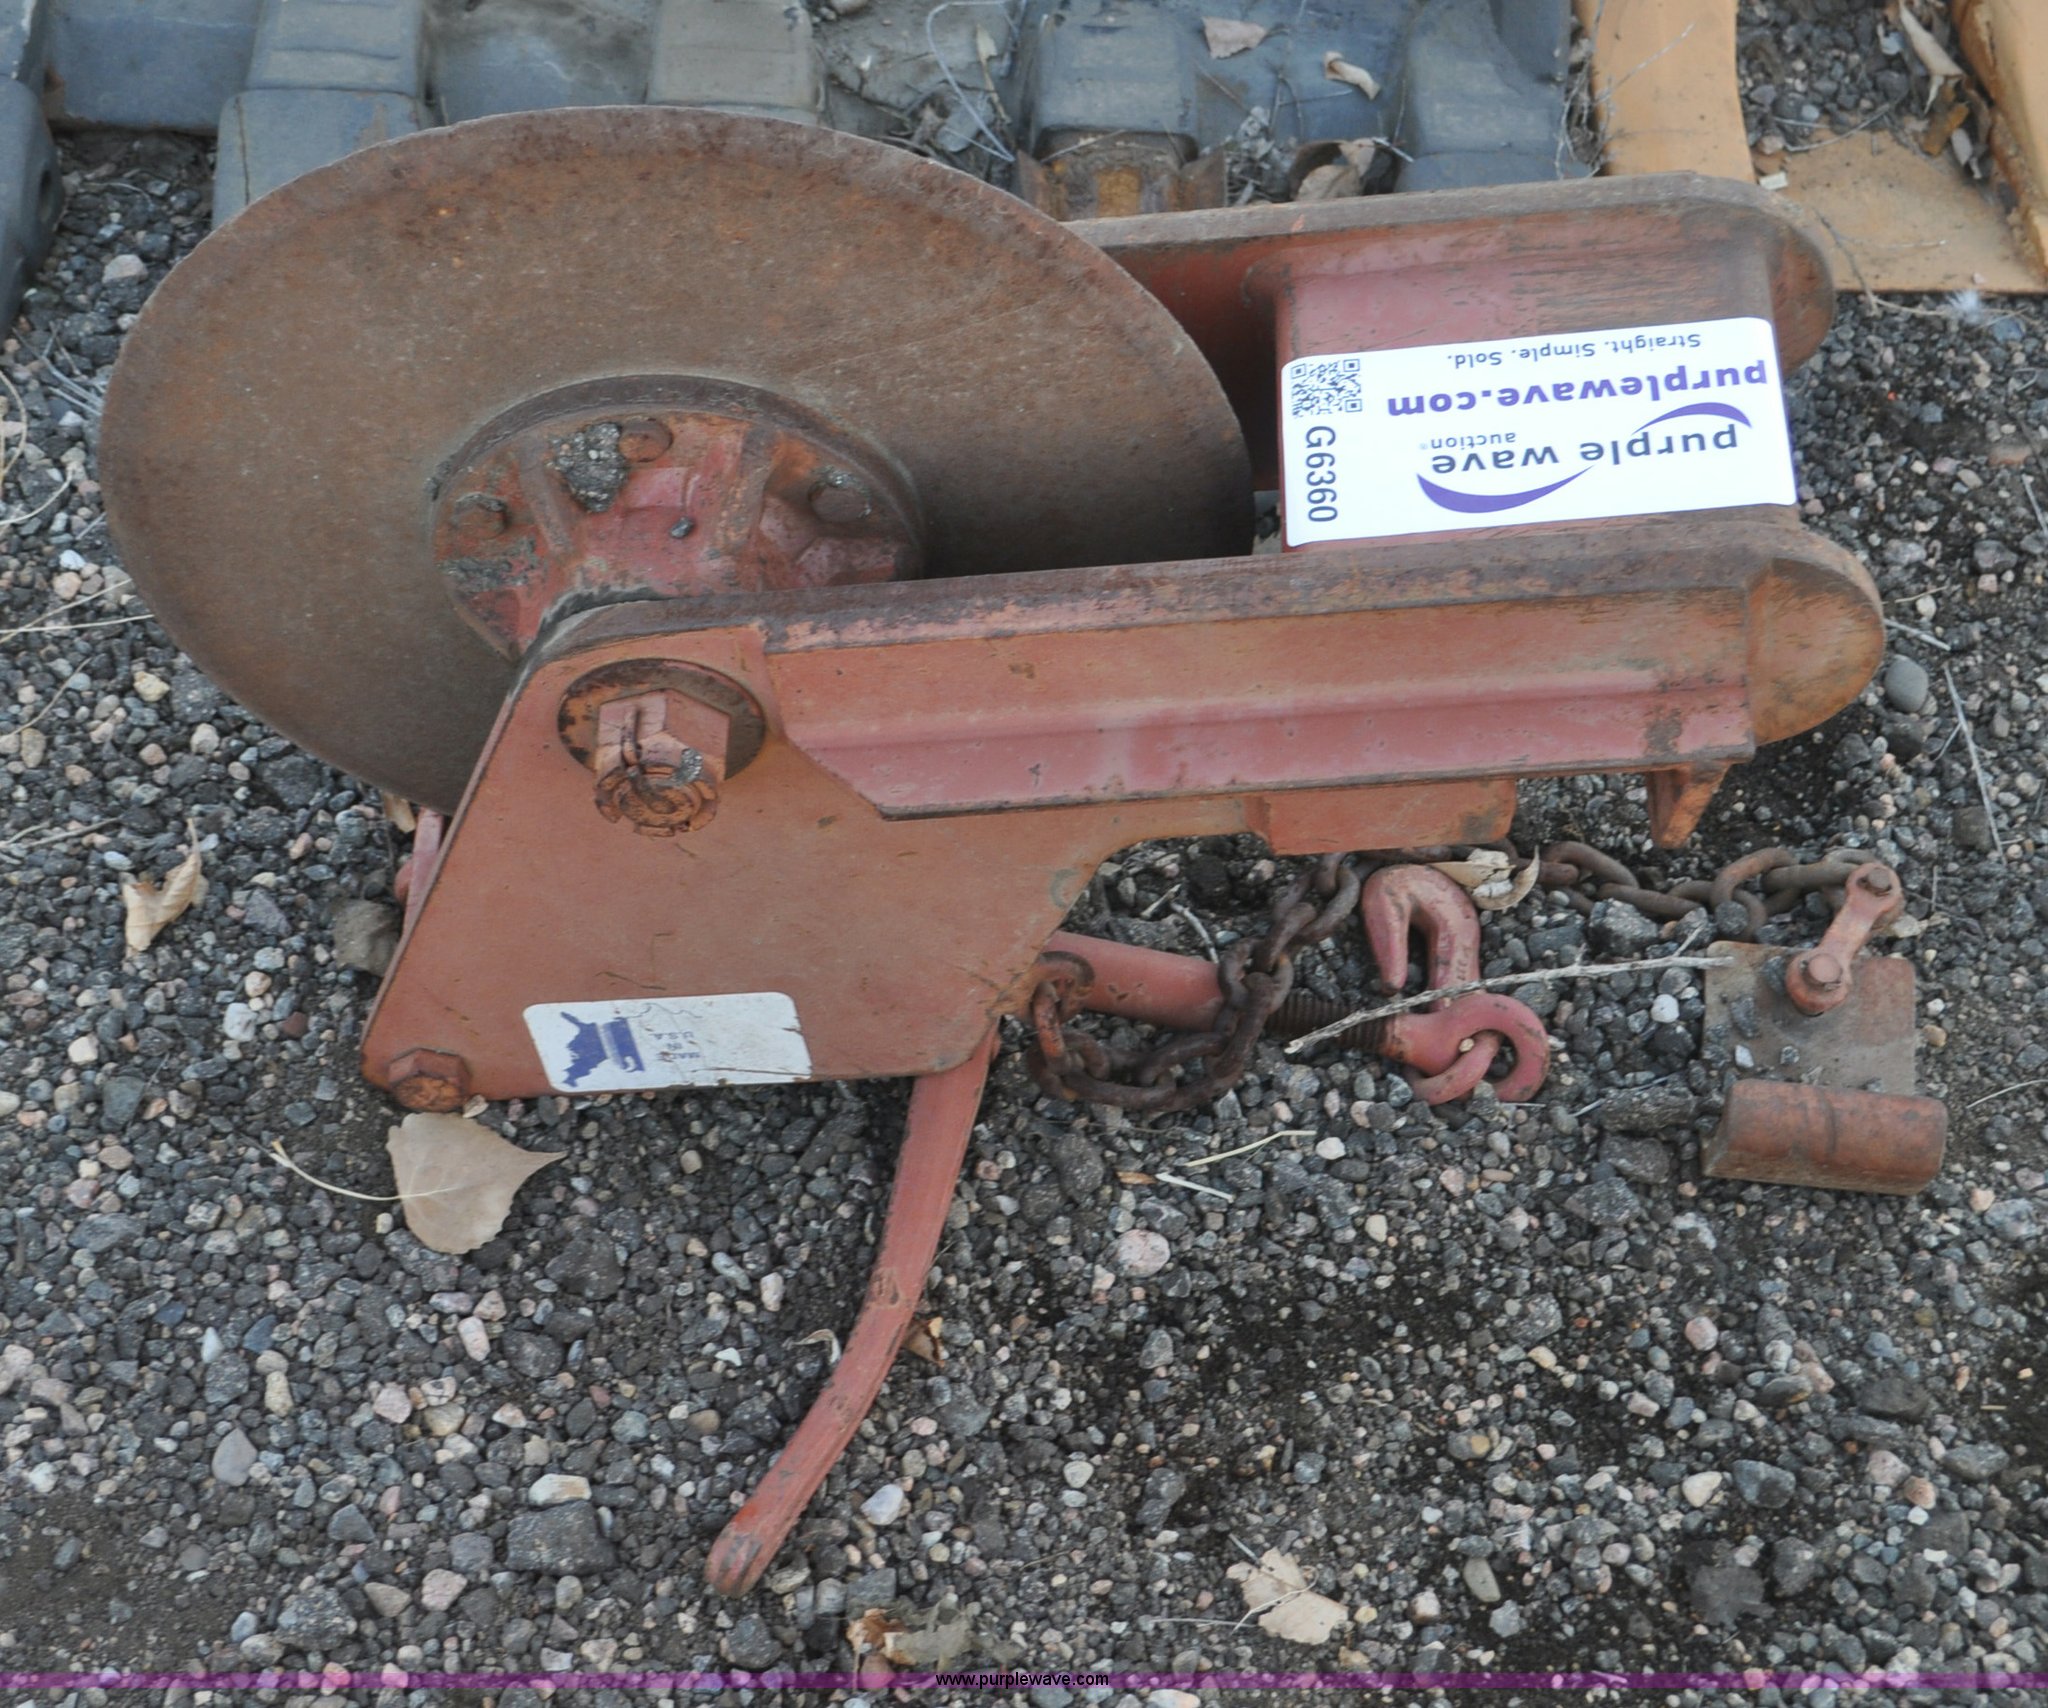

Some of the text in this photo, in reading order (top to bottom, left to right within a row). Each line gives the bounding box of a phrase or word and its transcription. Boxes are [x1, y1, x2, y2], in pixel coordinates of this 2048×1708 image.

[1448, 334, 1701, 369] Straight. Simple. Sold.
[1388, 361, 1767, 416] purplewave.com
[1305, 426, 1338, 522] G6360
[1432, 423, 1738, 474] purple wave
